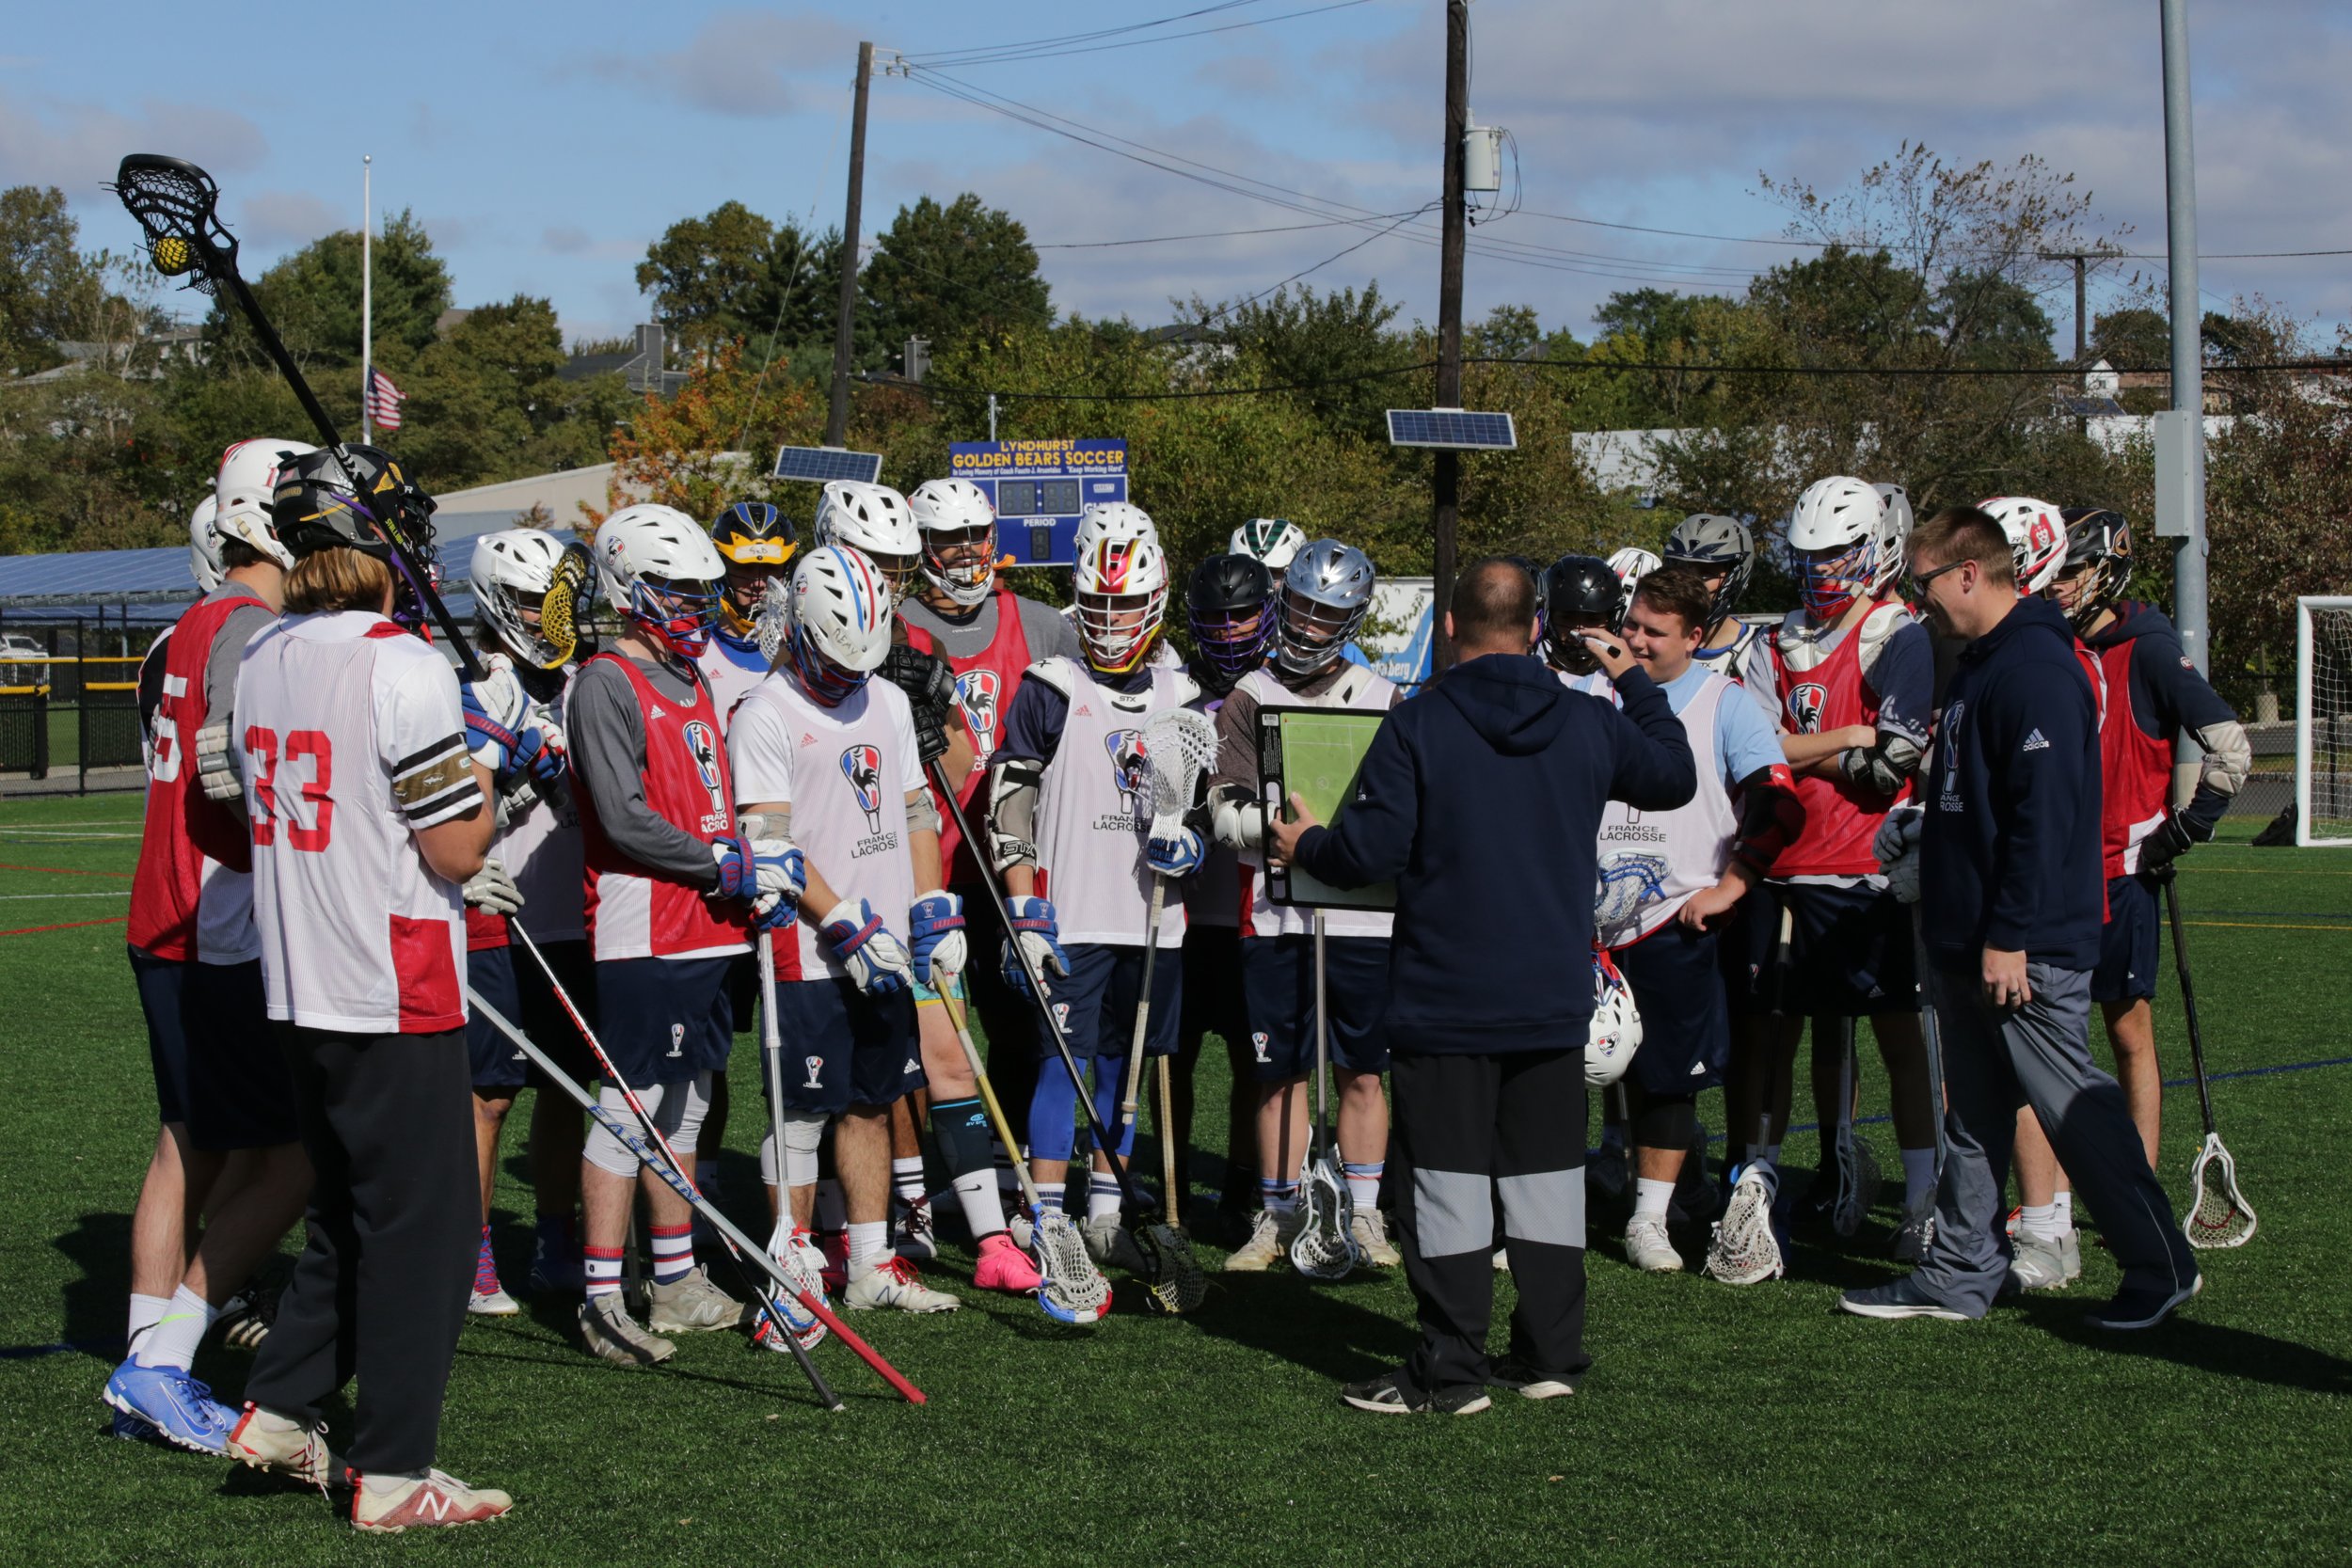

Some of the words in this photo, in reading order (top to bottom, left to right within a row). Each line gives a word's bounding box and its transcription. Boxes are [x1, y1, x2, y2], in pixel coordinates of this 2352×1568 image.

[1000, 440, 1074, 452] LYNDHURST
[952, 452, 1011, 467] GOLDEN
[1014, 451, 1061, 467] BEARS
[1065, 450, 1124, 466] SOCCER
[1024, 518, 1057, 527] PERIOD
[2030, 513, 2057, 553] M
[833, 627, 858, 655] REMY
[927, 659, 944, 696] BRINE
[2023, 740, 2049, 752] adidas
[245, 724, 333, 852] 33
[1940, 801, 1963, 812] ROSSE
[701, 812, 727, 823] FRAN
[1101, 815, 1147, 823] FRANCE
[701, 819, 728, 833] ACRO
[1599, 832, 1666, 843] LACROSSE
[1004, 842, 1035, 856] STX
[588, 1104, 703, 1204] EASTON
[416, 1491, 453, 1521] N
